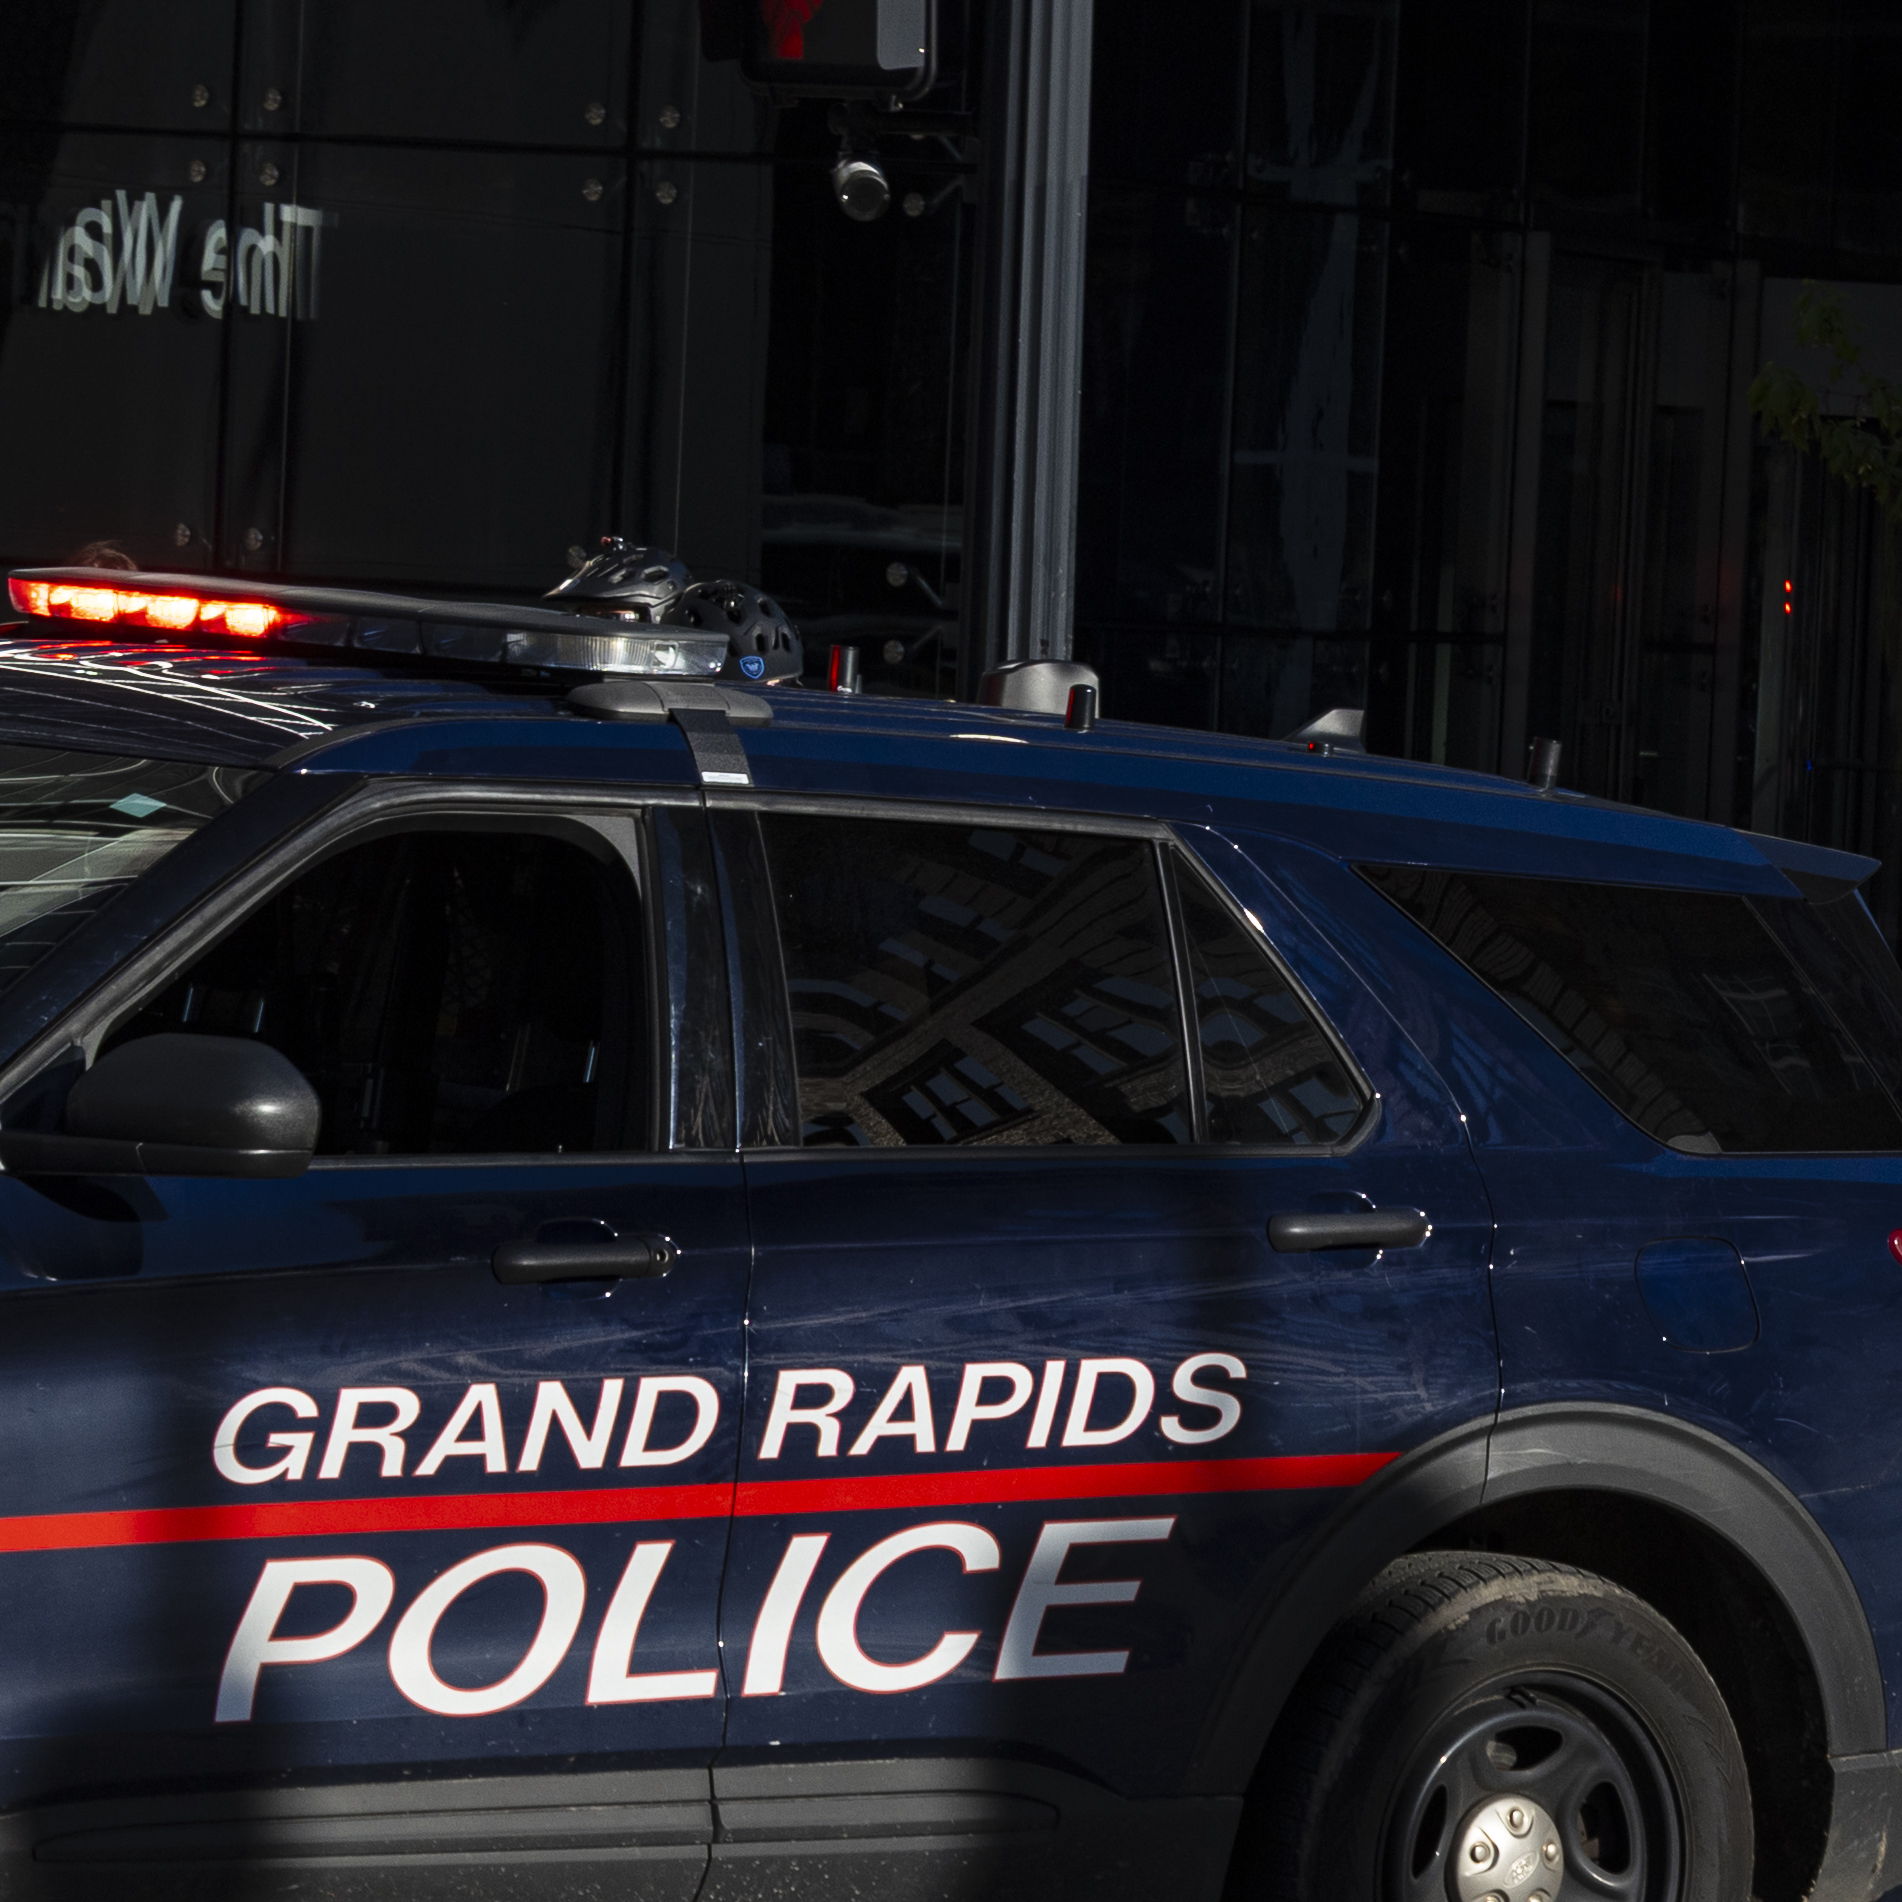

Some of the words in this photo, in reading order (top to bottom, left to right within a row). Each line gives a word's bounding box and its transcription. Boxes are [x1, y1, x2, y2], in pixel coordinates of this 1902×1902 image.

[211, 1375, 722, 1486] GRAND
[756, 1351, 1249, 1461] RAPIDS
[214, 1515, 1176, 1724] POLICE
